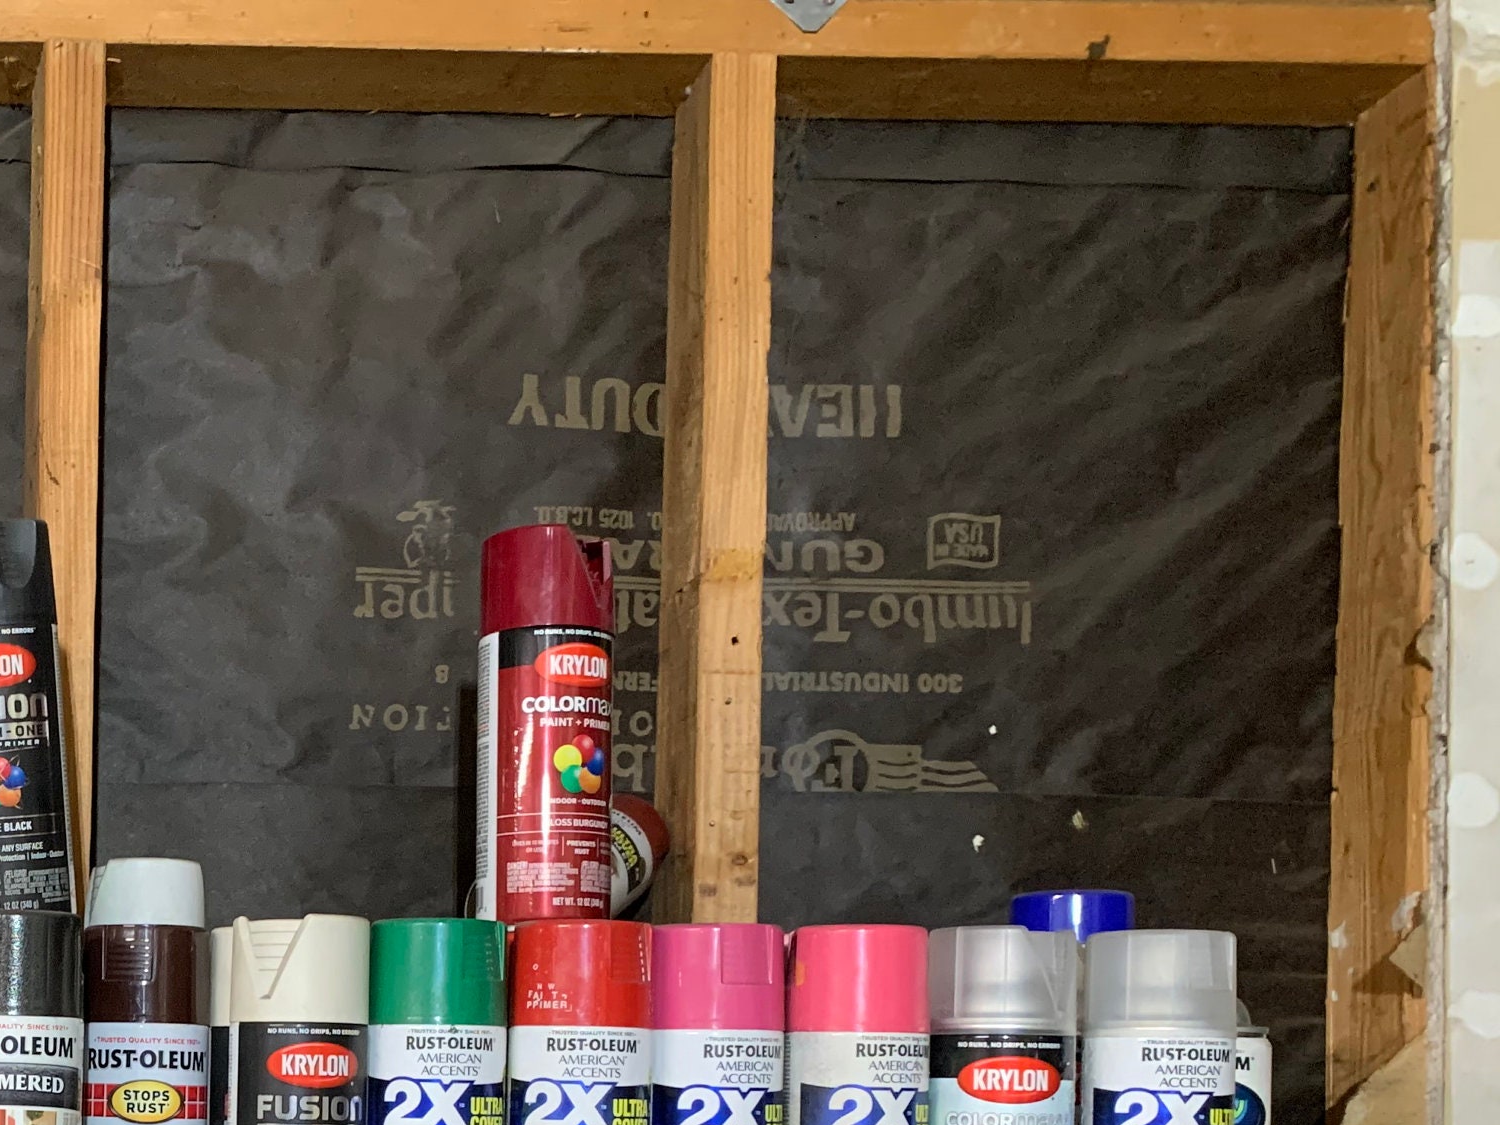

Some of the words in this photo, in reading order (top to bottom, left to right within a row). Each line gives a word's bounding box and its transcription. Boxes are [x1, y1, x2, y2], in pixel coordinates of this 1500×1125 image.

[550, 654, 607, 679] KRYLON
[918, 672, 963, 693] 300
[406, 1037, 493, 1051] RUST-OLEUM
[547, 1037, 637, 1053] RUST-OLEUM
[89, 1048, 204, 1071] RUST-OLEUM
[417, 1054, 481, 1064] AMERICAN
[1142, 1047, 1229, 1062] RUST-OLEUM
[282, 1054, 348, 1076] KRYLON
[559, 1055, 625, 1066] AMERICAN
[716, 1061, 773, 1071] AMERICAN
[421, 1066, 478, 1076] ACCENTS
[562, 1068, 621, 1078] ACCENTS
[1155, 1065, 1220, 1075] AMERICAN
[720, 1073, 771, 1083] ACCENTS
[873, 1074, 920, 1084] ACCENTS
[973, 1068, 1048, 1091] KRYLON
[1159, 1078, 1217, 1088] ACCENTS
[123, 1090, 170, 1101] STOPS
[126, 1102, 166, 1114] RUST
[613, 1099, 648, 1117] ULTRA
